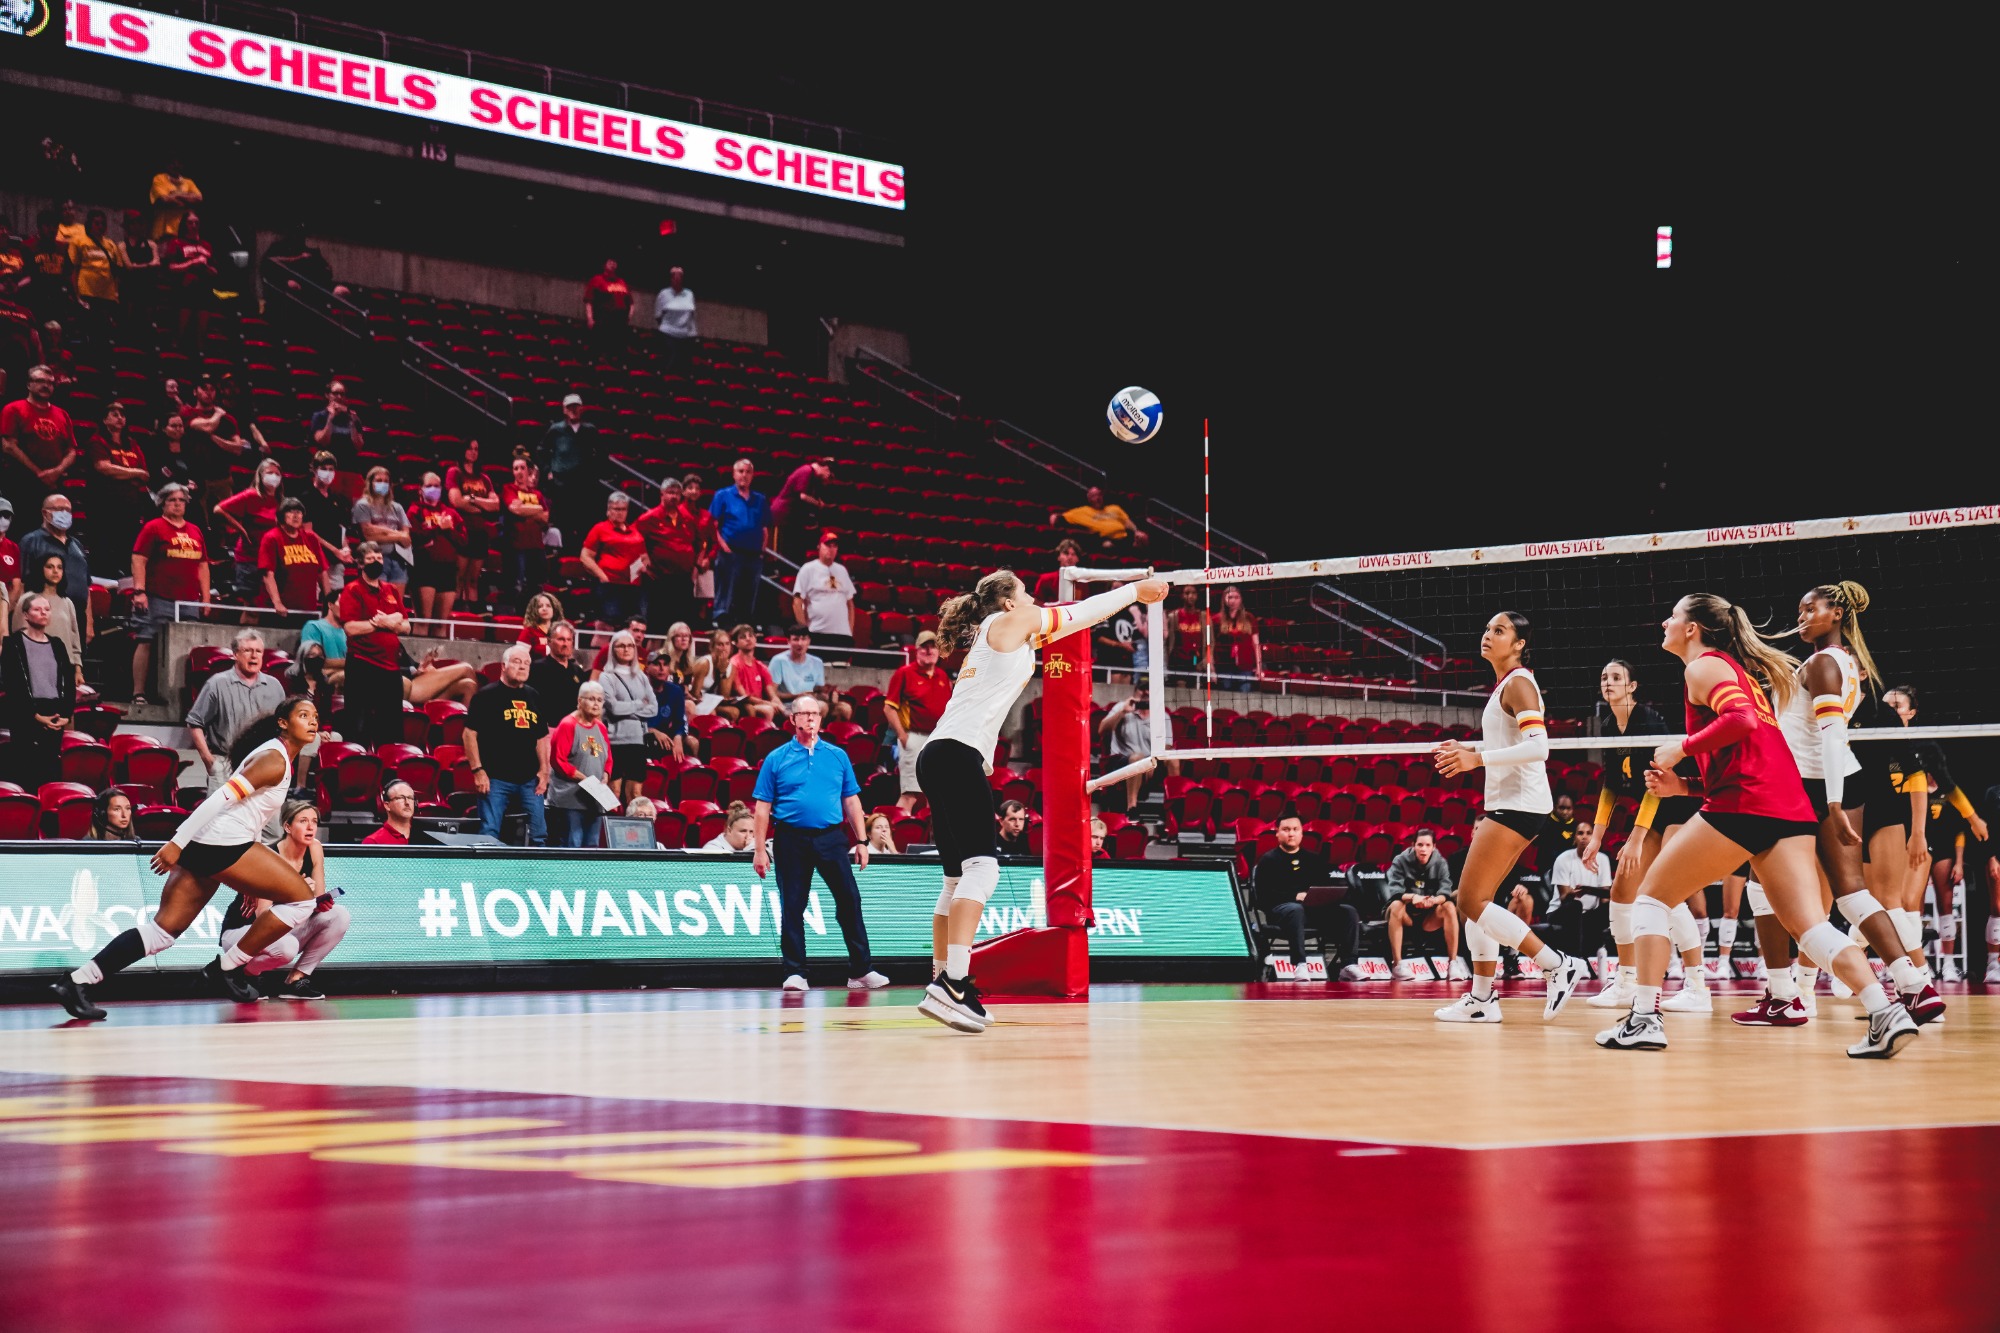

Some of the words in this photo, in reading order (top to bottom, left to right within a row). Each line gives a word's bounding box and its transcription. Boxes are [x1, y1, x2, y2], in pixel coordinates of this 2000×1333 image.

[66, 2, 150, 53] LS
[188, 29, 437, 111] SCHEELS
[470, 88, 686, 161] SCHEELS
[715, 137, 905, 202] SCHEELS
[1121, 398, 1144, 424] molten
[1908, 510, 1952, 526] IOWA
[1954, 506, 2000, 522] STAT
[1706, 527, 1745, 542] IOWA
[1747, 521, 1795, 539] STATE
[1525, 543, 1560, 557] IOWA
[1561, 538, 1605, 554] STATE
[1358, 554, 1391, 569] IOWA
[1392, 552, 1432, 566] STATE
[1237, 564, 1274, 578] STATE
[1044, 660, 1072, 673] STATE
[503, 708, 538, 724] STATE
